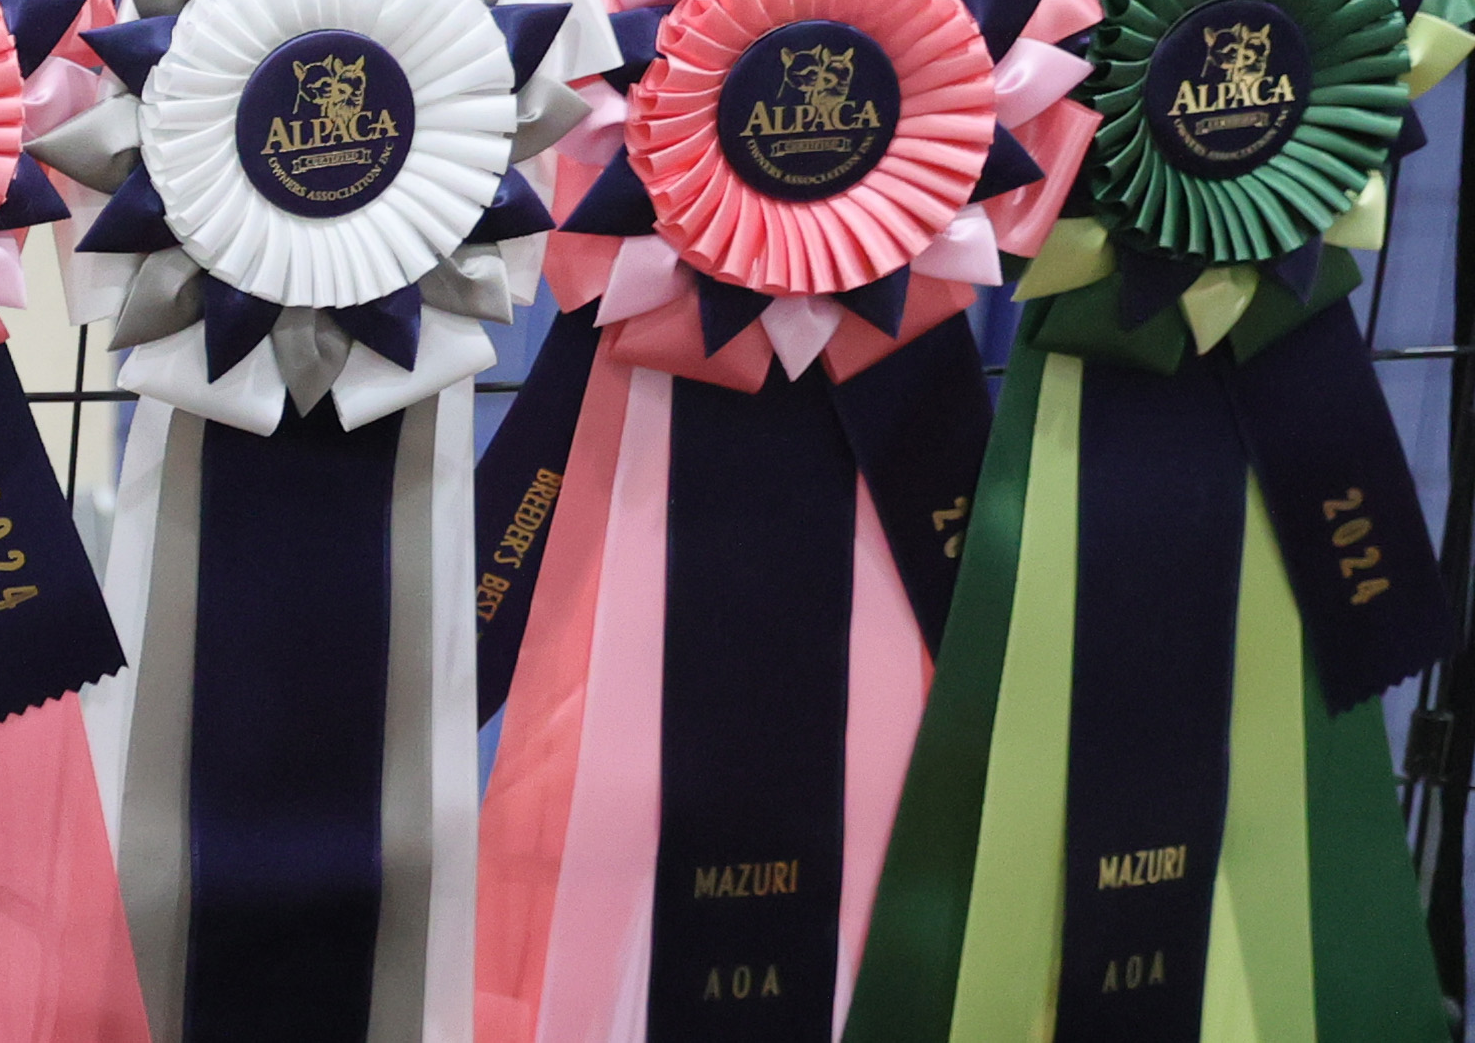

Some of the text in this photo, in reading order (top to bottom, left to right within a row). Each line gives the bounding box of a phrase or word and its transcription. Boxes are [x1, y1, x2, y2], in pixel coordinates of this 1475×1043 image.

[1167, 74, 1295, 116] ALPACA
[260, 109, 399, 154] ALPACA
[740, 100, 881, 136] ALPACA
[268, 141, 395, 201] OWNERS ASSOCIATION INC
[1322, 487, 1390, 605] 2024
[693, 859, 799, 899] MAZURI
[1098, 844, 1187, 890] MAZURI
